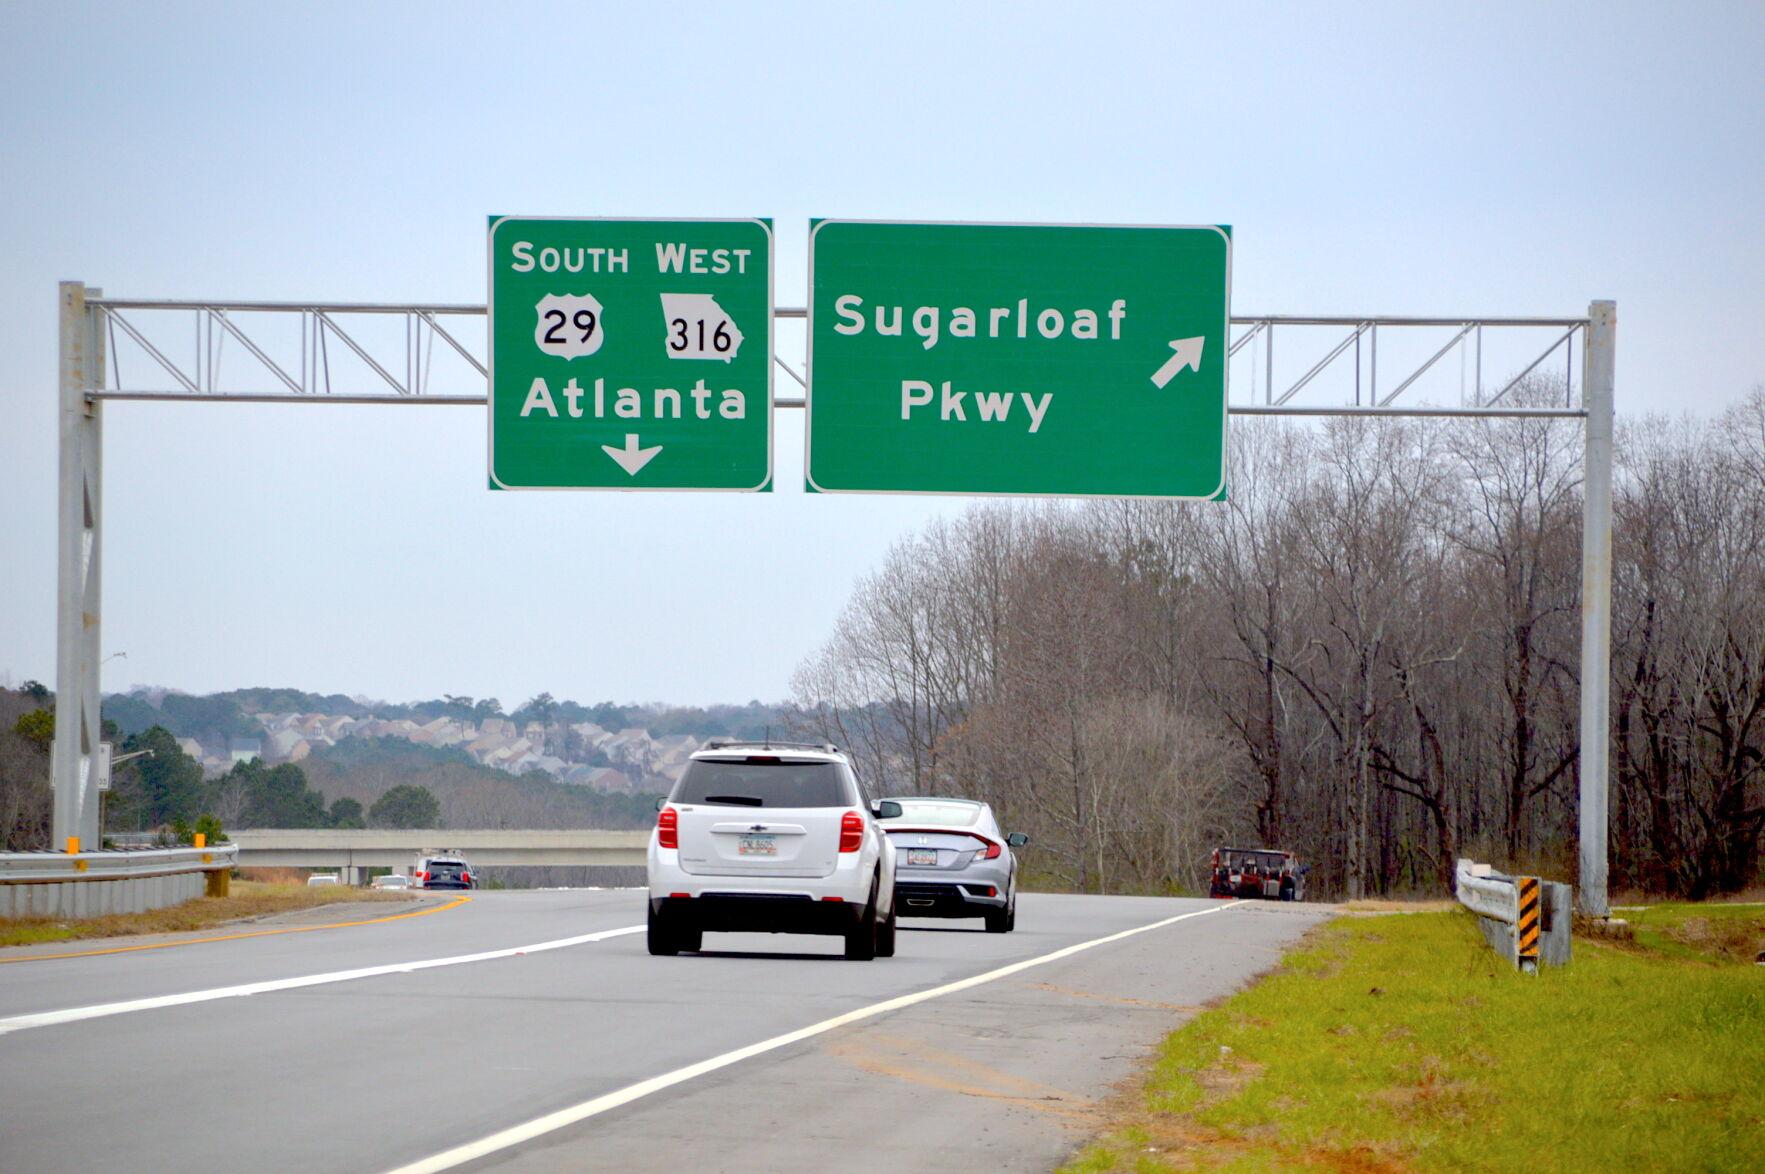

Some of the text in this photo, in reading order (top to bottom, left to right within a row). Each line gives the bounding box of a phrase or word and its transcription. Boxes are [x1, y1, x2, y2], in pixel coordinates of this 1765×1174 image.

[512, 241, 629, 273] SOUTH
[655, 242, 752, 274] WEST
[543, 309, 596, 344] 29
[670, 318, 732, 352] 316
[834, 294, 1126, 351] Sugarloaf
[519, 377, 746, 420] Atlanta
[901, 380, 1054, 434] Pkwy
